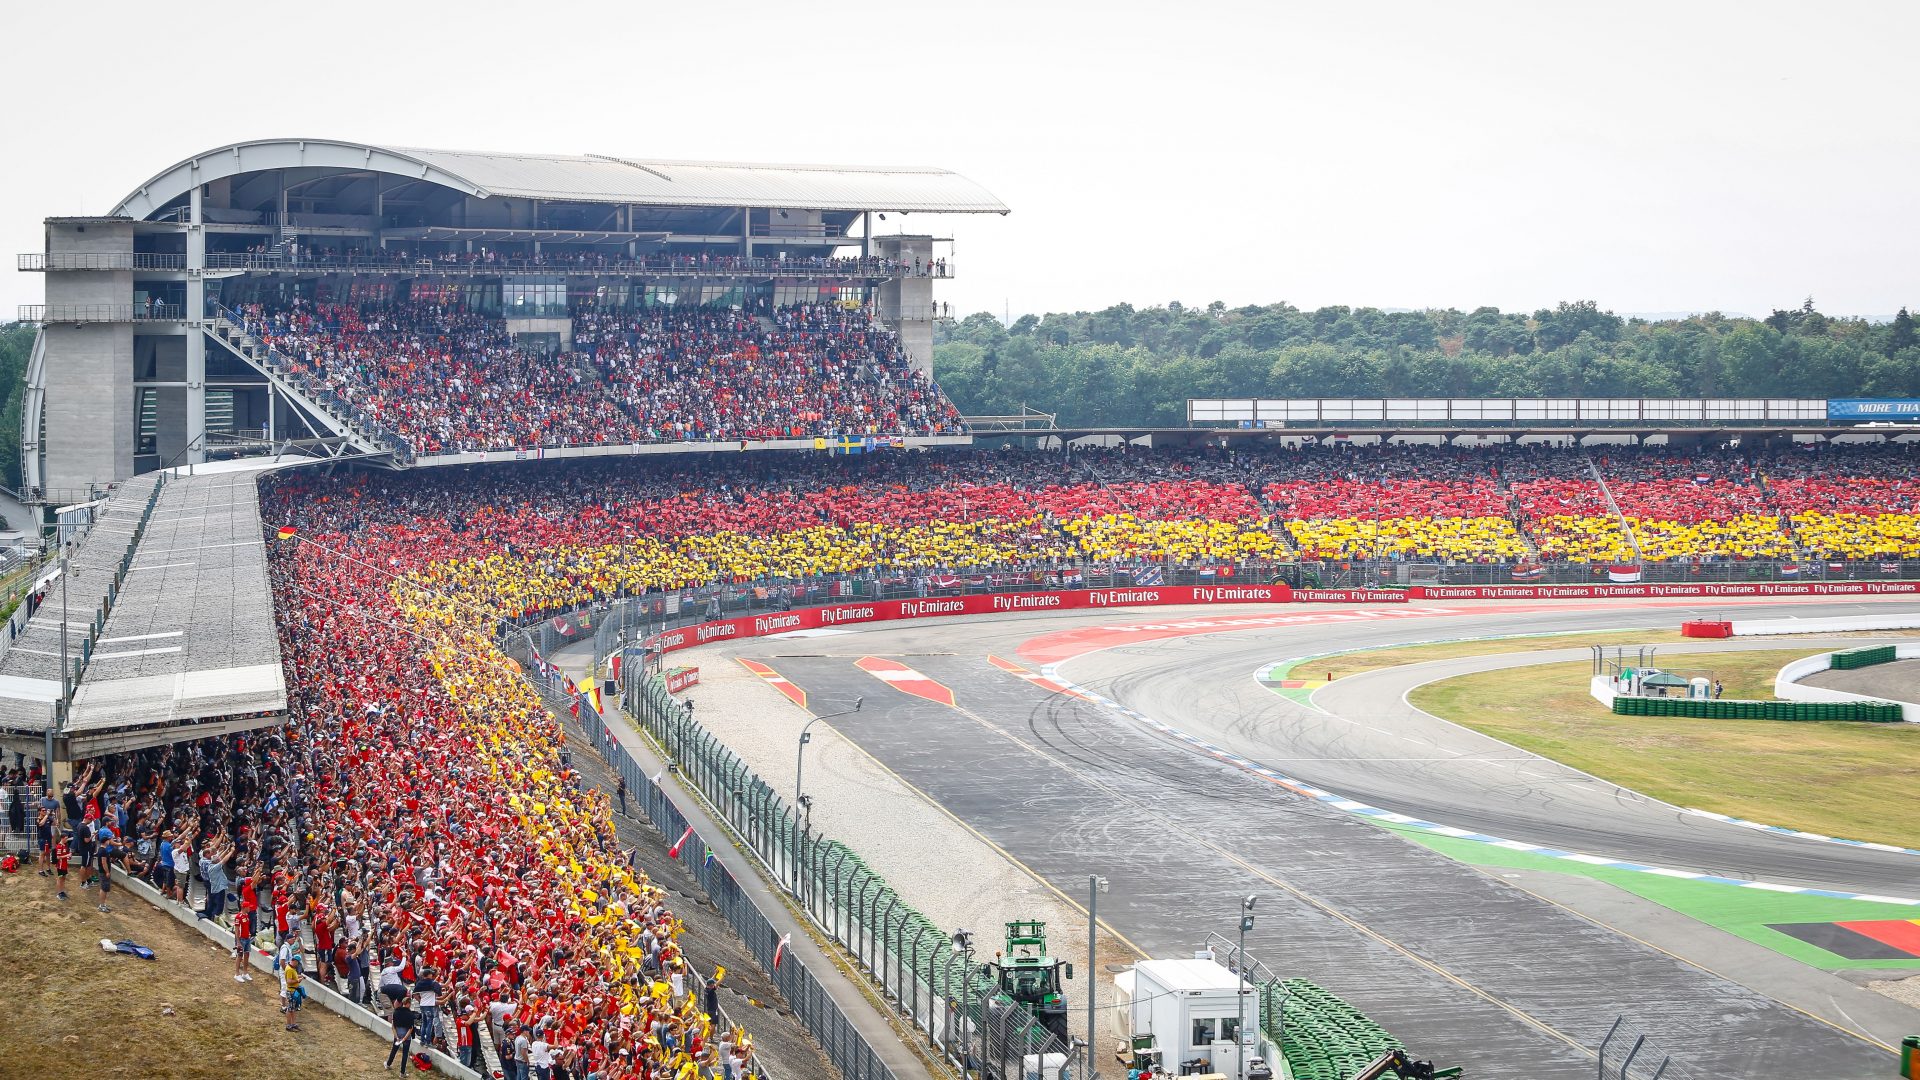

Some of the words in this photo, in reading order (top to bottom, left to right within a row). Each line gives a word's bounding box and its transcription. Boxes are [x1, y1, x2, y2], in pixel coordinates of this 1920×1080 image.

[1857, 403, 1893, 413] MORE
[1425, 588, 1439, 598] Fly
[1440, 588, 1477, 597] Emirates
[1482, 588, 1496, 598] Fly
[1497, 588, 1534, 597] Emirates
[1538, 588, 1552, 597] Fly
[1553, 587, 1589, 596] Emirates
[1594, 587, 1608, 597] Fly
[1609, 586, 1645, 595] Emirates
[1650, 586, 1664, 596] Fly
[1665, 586, 1700, 594] Emirates
[1705, 586, 1719, 595] Fly
[1720, 585, 1756, 594] Emirates
[1760, 585, 1774, 594] Fly
[1774, 585, 1809, 593] Emirates
[1814, 584, 1828, 594] Fly
[1829, 584, 1863, 593] Emirates
[1867, 584, 1881, 593] Fly
[1882, 583, 1916, 592] Emirates
[1090, 592, 1107, 606] Fly
[1110, 590, 1159, 603] Emirates
[1193, 588, 1214, 602] Fly
[1216, 587, 1271, 600] Emirates
[1293, 591, 1308, 601] Fly
[1309, 591, 1346, 600] Emirates
[1351, 591, 1366, 601] Fly
[1367, 591, 1405, 600] Emirates
[993, 596, 1011, 610] Fly
[1013, 594, 1060, 608] Emirates
[901, 602, 917, 617] Fly
[919, 600, 964, 613] Emirates
[821, 609, 835, 624] Fly
[836, 606, 874, 621] Emirates
[755, 618, 769, 633] Fly
[769, 613, 801, 629] Emirates
